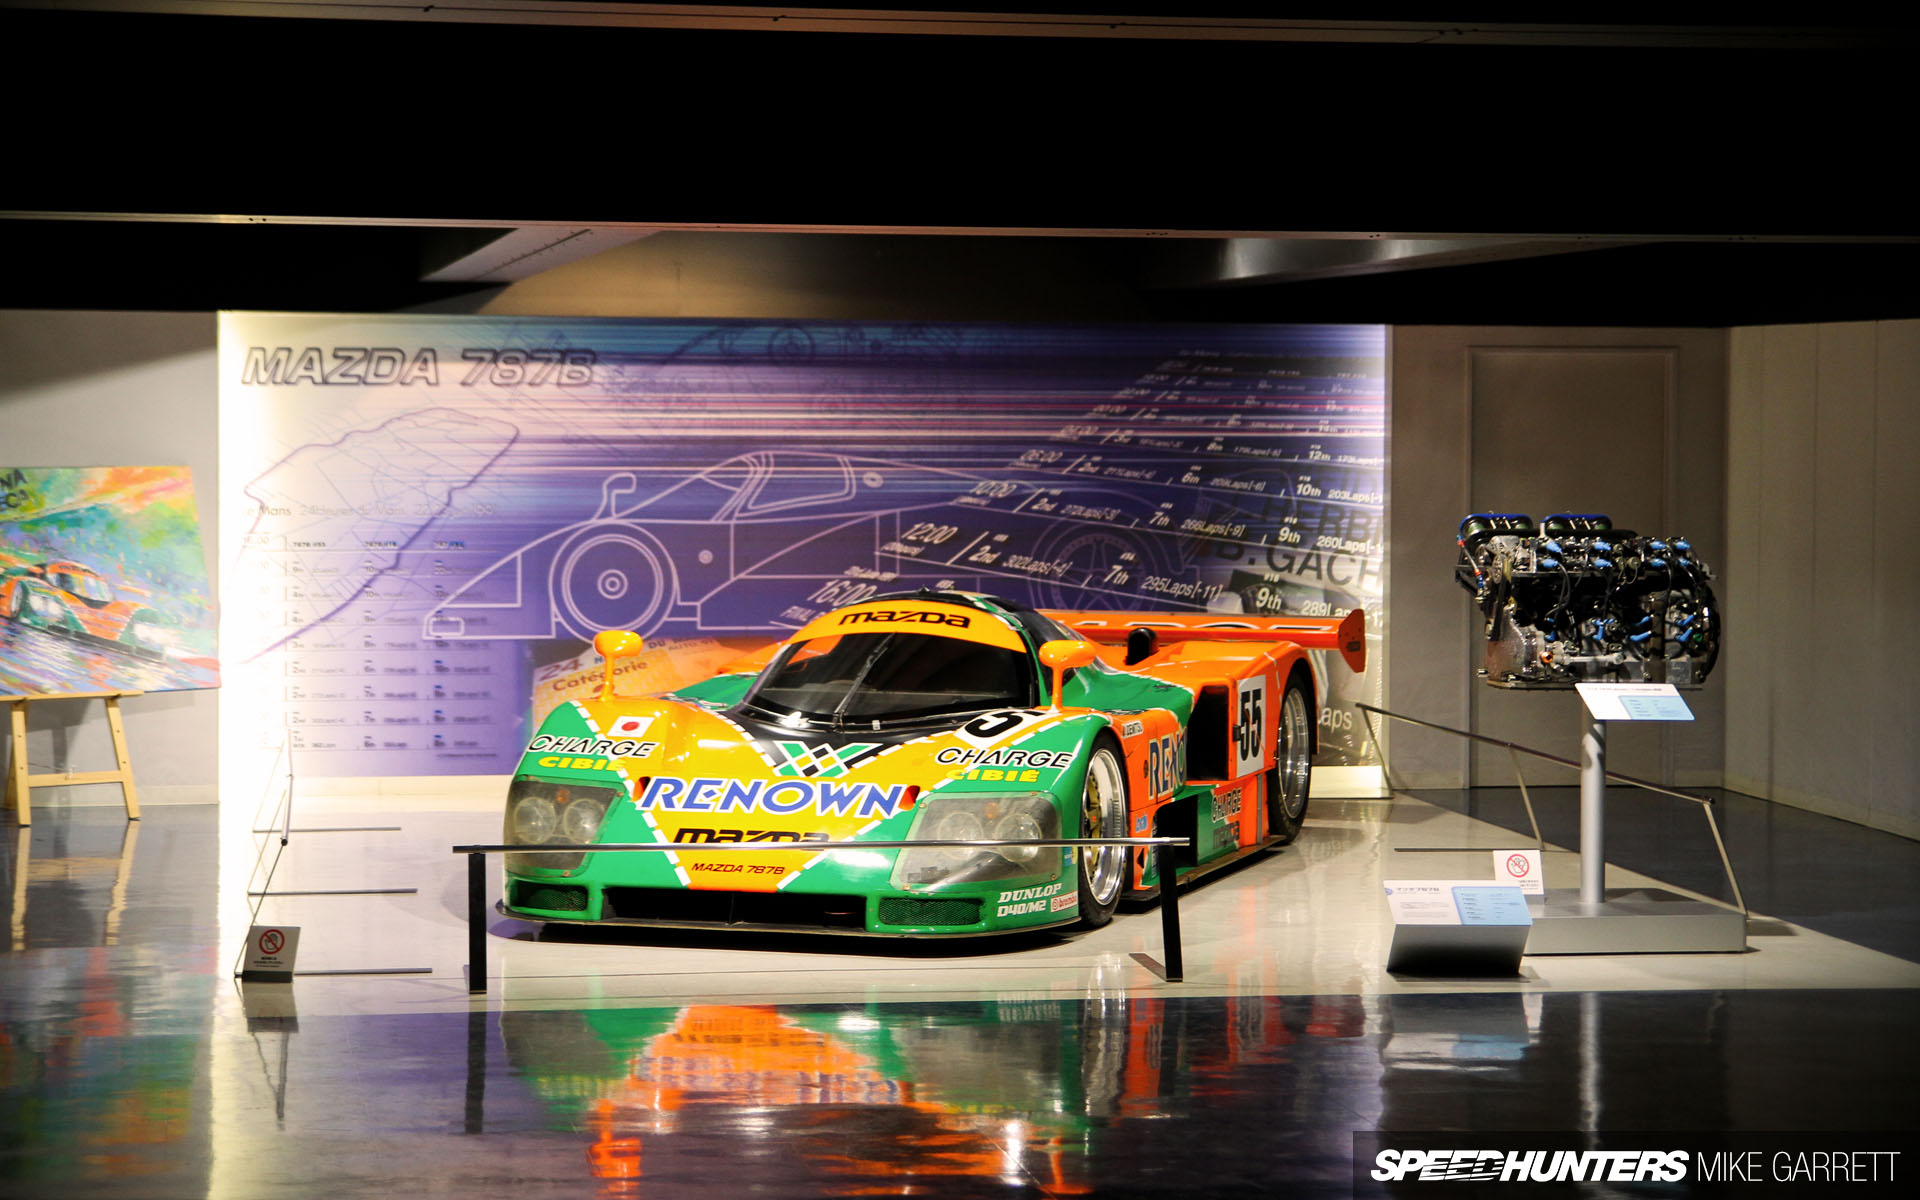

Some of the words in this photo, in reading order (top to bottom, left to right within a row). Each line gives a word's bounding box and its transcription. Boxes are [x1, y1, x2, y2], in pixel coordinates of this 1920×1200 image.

[241, 347, 439, 386] MAZDA
[460, 347, 599, 386] 787B
[1296, 483, 1322, 497] 10th
[1149, 511, 1170, 527] 7th
[901, 522, 958, 545] 12:00
[1278, 526, 1301, 543] 9th
[968, 545, 1000, 564] 2nd
[1104, 564, 1129, 585] 7th
[1140, 575, 1223, 602] 295Laps[-11]
[1255, 587, 1282, 610] 9th
[838, 610, 972, 630] mazda
[541, 659, 583, 681] 24
[1240, 688, 1262, 762] 55
[528, 735, 657, 757] CHARGE
[936, 748, 1074, 768] CHARGE
[639, 777, 905, 819] RENOWN
[691, 863, 744, 874] MAZDA
[747, 864, 785, 875] 787B
[997, 883, 1063, 904] DUNLOP
